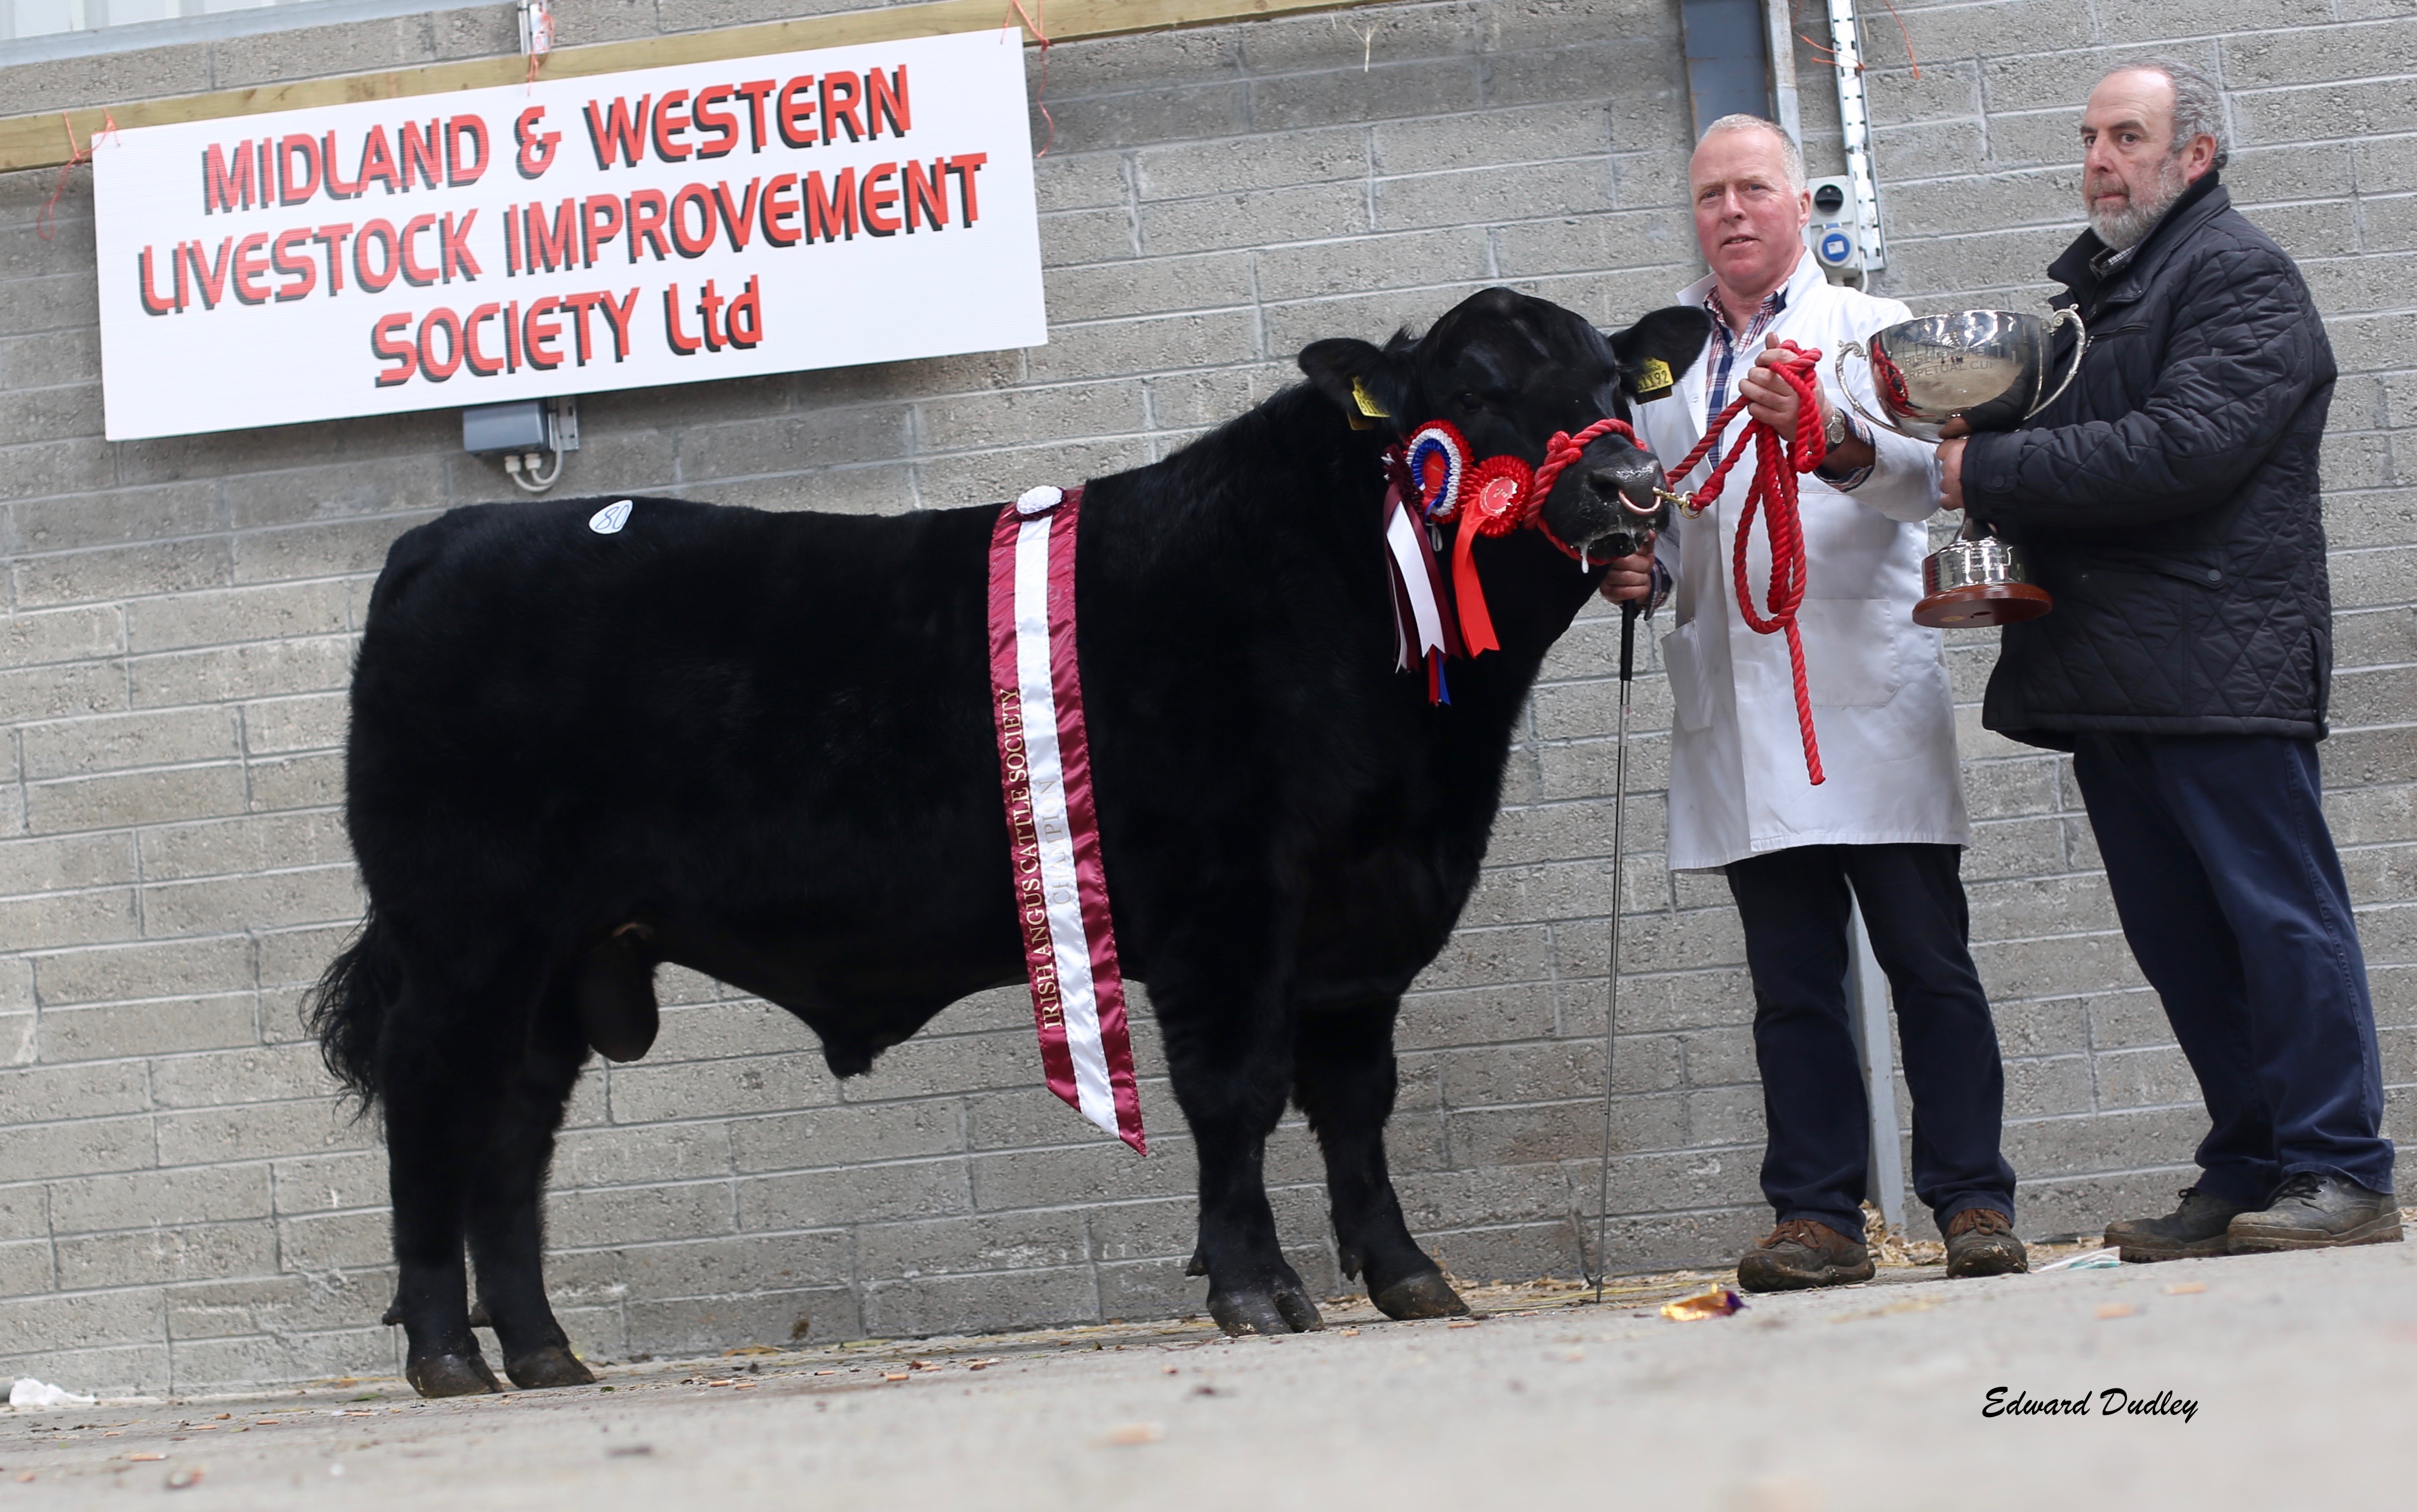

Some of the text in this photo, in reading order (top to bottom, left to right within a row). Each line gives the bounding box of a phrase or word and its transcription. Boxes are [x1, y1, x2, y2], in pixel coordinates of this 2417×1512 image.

[202, 64, 911, 215] MIDLAND & WESTERN
[139, 152, 987, 316] LIVESTOCK IMPROVEMENT
[373, 275, 763, 388] SOCIETY Ltd
[1901, 363, 1967, 381] ERPETUAL
[595, 504, 630, 530] 80
[1000, 687, 1064, 1030] IRISH ANGUS CATTLE SOCIETY
[1039, 778, 1071, 905] CHAMPION
